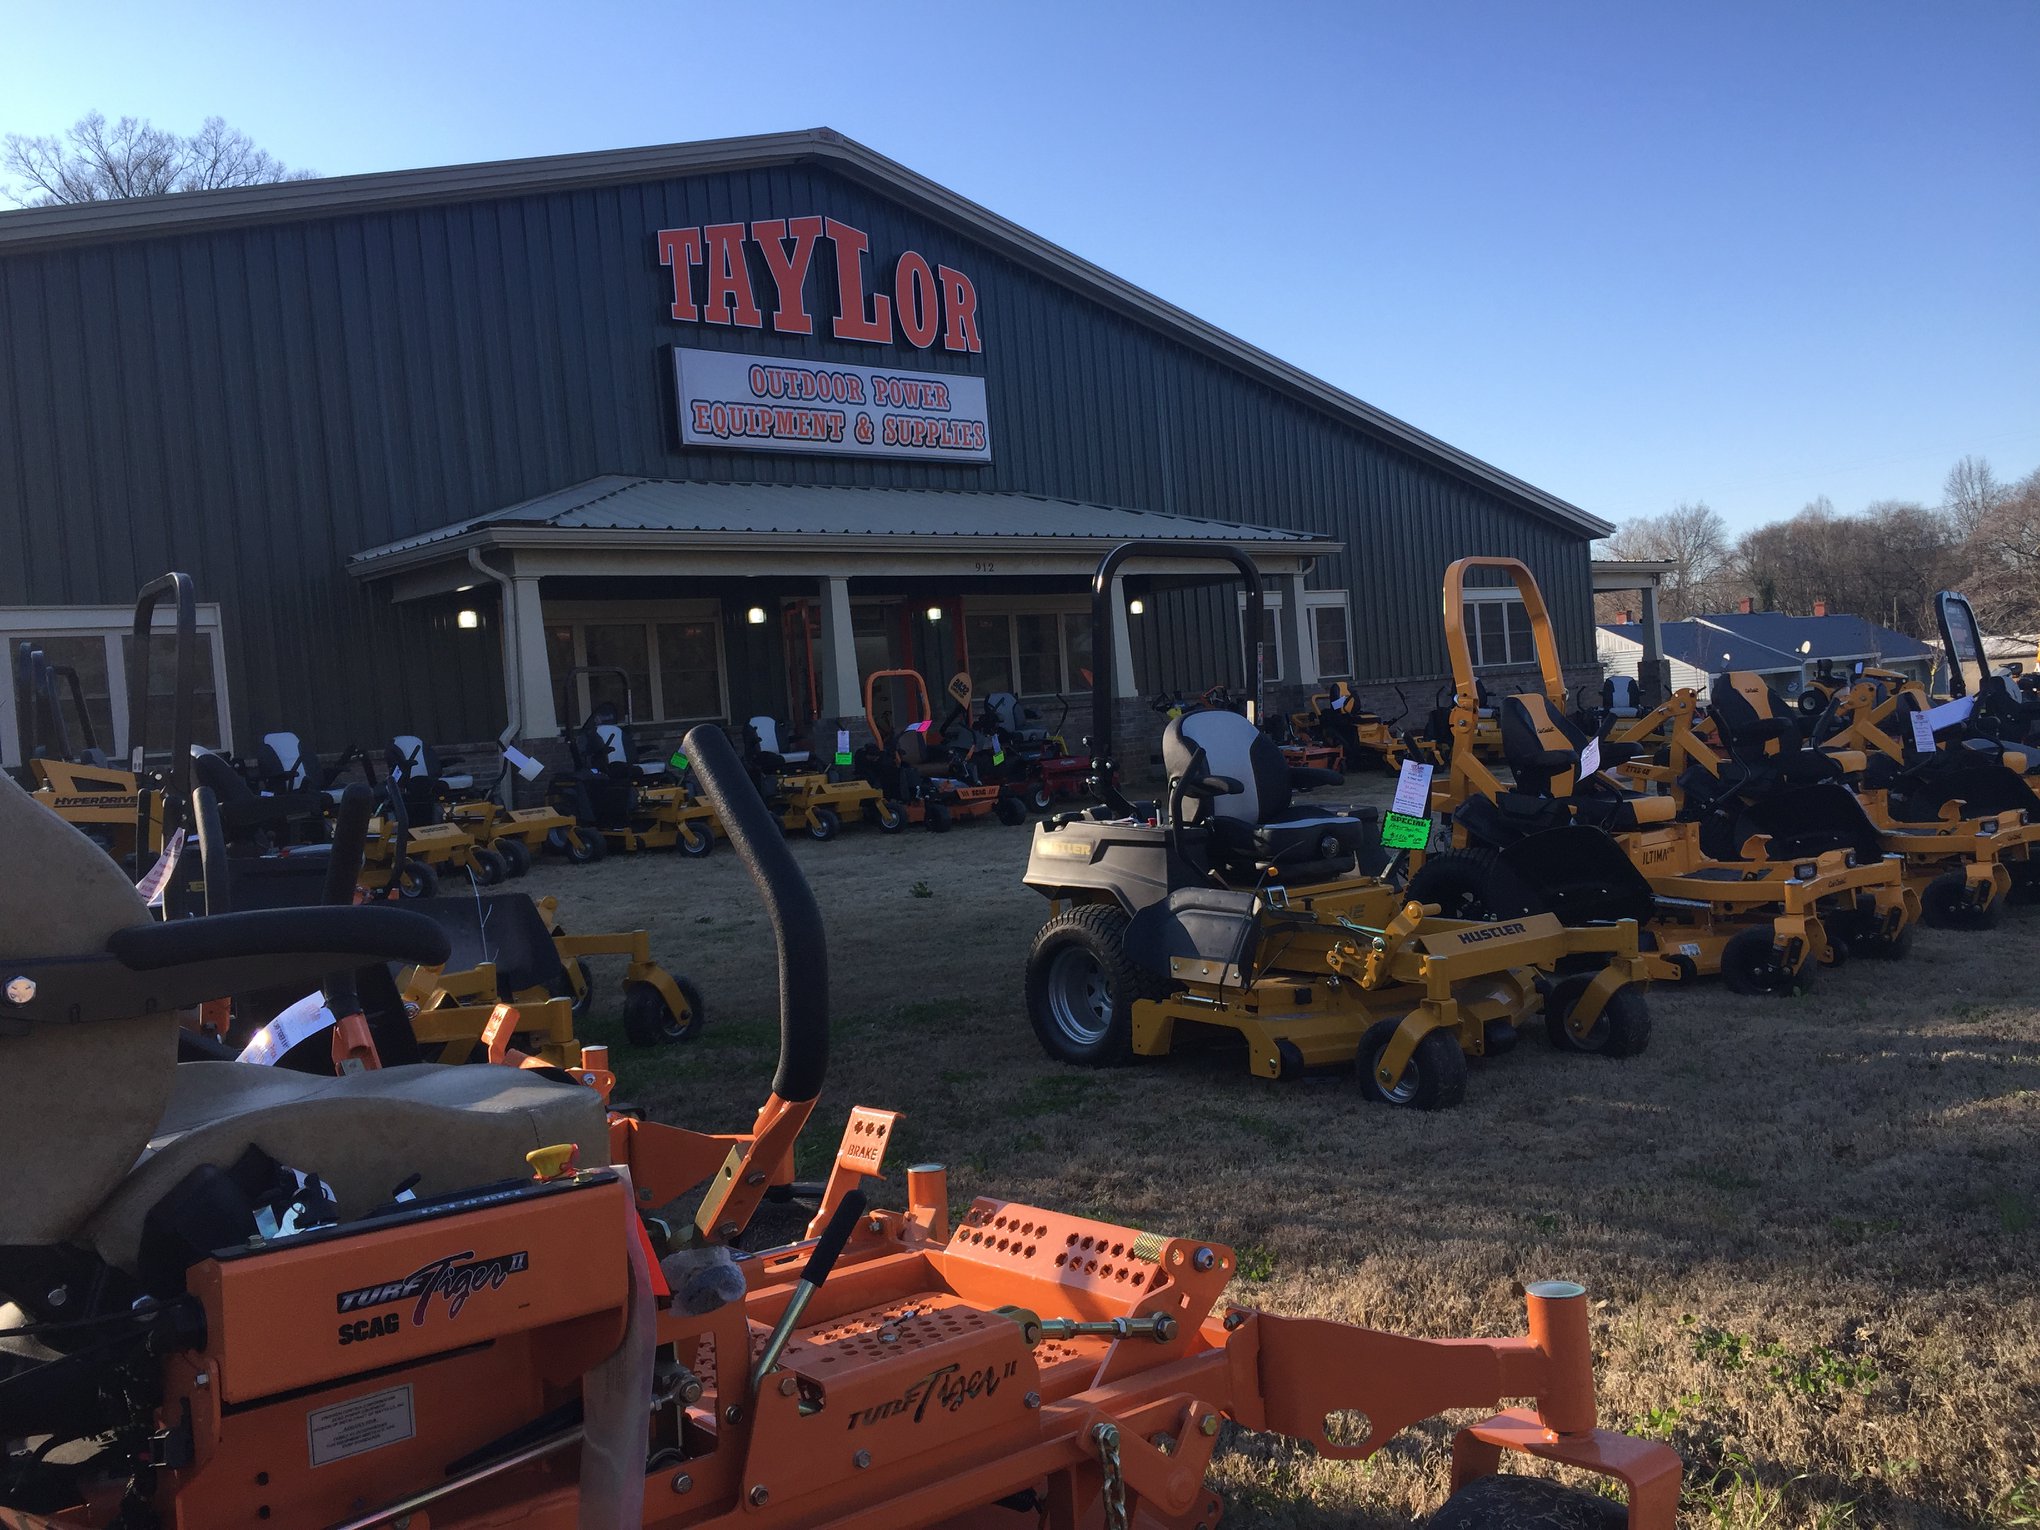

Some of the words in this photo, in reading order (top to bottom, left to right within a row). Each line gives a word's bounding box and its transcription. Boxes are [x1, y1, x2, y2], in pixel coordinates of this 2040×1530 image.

[657, 215, 982, 354] TAYLOR
[748, 363, 864, 403] OUTDOOR
[871, 374, 951, 411] POWER
[691, 399, 845, 443] EQUIPMENT
[854, 411, 875, 443] &
[882, 413, 986, 450] SUPPLIES
[975, 562, 994, 572] 912
[54, 796, 138, 806] HYPERDRIVE
[1390, 815, 1426, 828] SPECIAL
[1037, 839, 1091, 856] STLER
[1457, 922, 1526, 944] HUSTLER
[847, 1144, 878, 1161] BRAKE
[340, 1277, 424, 1311] TURF
[403, 1250, 508, 1328] Tiger
[338, 1312, 400, 1346] SCAG
